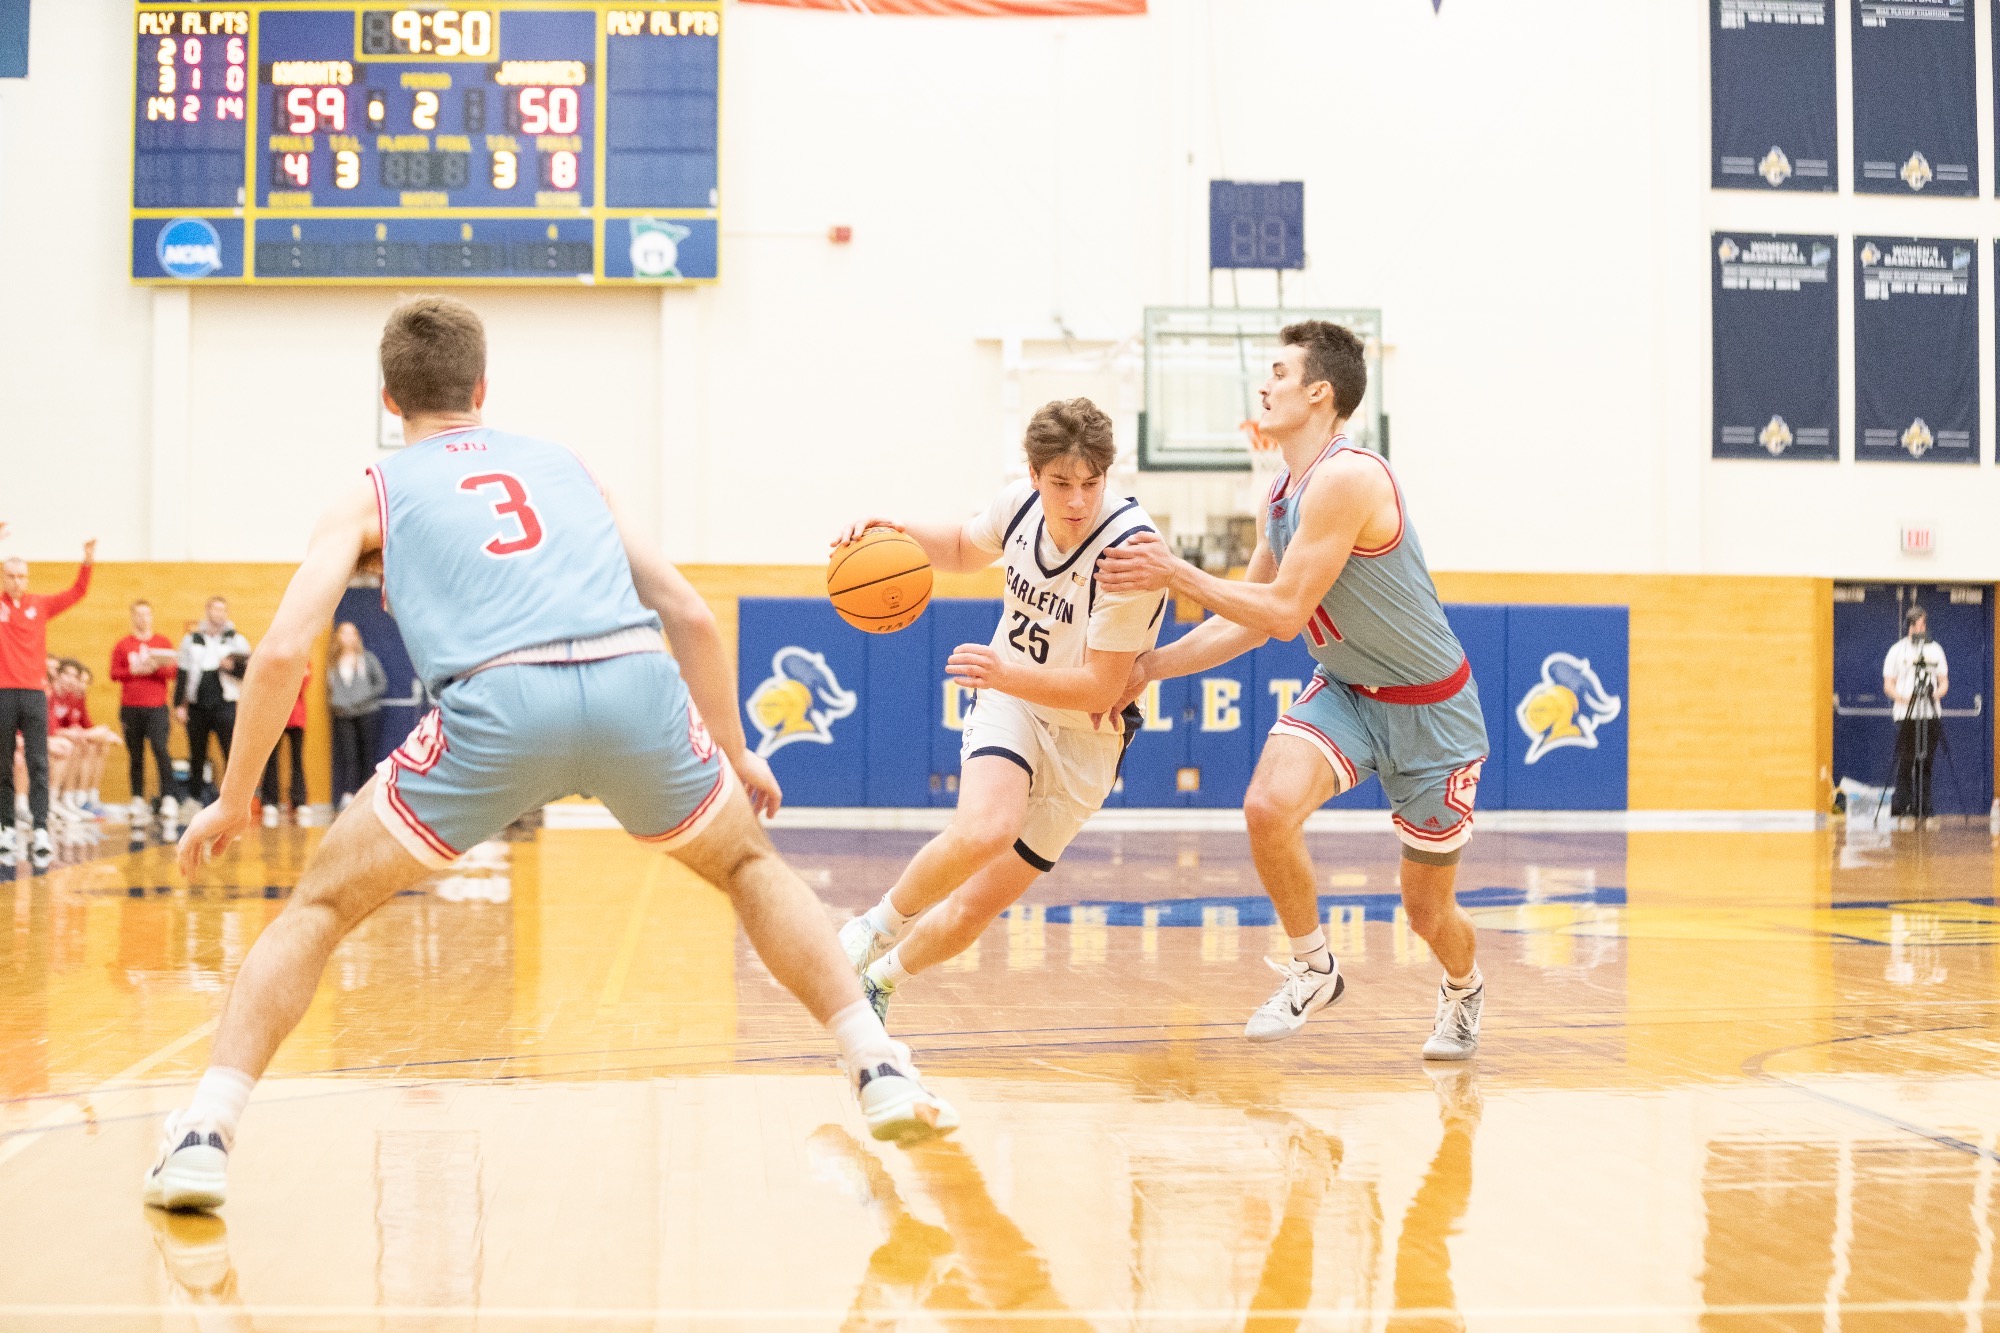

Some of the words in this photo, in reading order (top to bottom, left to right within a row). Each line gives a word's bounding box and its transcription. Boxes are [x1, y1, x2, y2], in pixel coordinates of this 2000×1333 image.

[209, 12, 249, 34] PTS
[392, 10, 491, 56] 9:50
[678, 11, 719, 36] PTS
[157, 38, 177, 65] 2
[183, 38, 202, 64] 0
[226, 37, 245, 64] 6
[158, 65, 176, 93] 3
[192, 67, 201, 89] 1
[226, 65, 245, 92] 0
[147, 96, 176, 121] 14
[182, 95, 201, 122] 2
[216, 97, 244, 120] 14
[287, 87, 345, 134] 59
[412, 91, 439, 130] 2
[519, 87, 578, 134] 50
[284, 153, 309, 186] 4
[336, 150, 360, 189] 3
[492, 150, 517, 189] 3
[551, 151, 577, 188] 8
[456, 470, 547, 561] 3
[1006, 565, 1074, 625] CARLETON
[1008, 609, 1050, 665] 25
